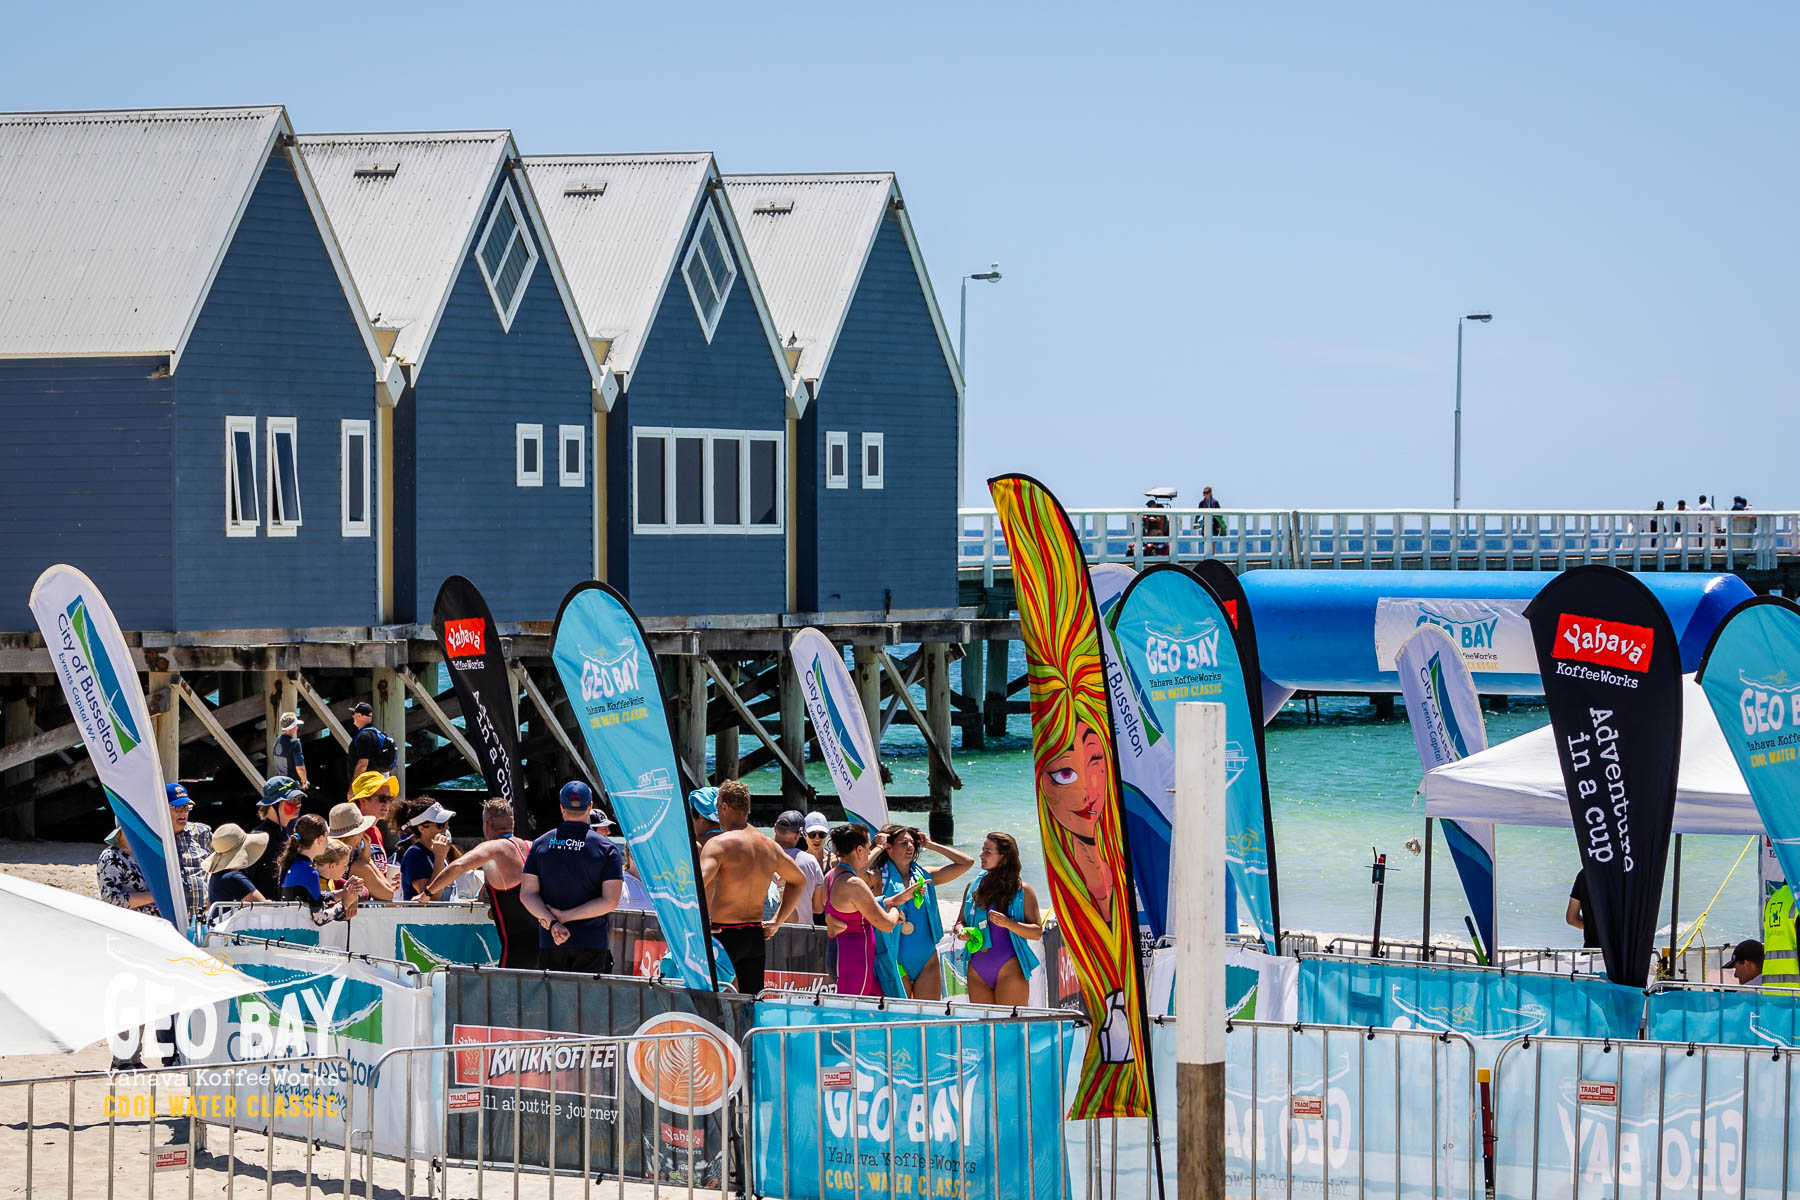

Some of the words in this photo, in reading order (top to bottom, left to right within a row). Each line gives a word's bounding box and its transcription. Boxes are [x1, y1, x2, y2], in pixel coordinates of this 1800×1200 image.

[448, 624, 481, 651] Yahava
[1145, 636, 1181, 675] GEO
[1186, 629, 1219, 670] BAY
[1461, 617, 1499, 649] BAY
[1563, 623, 1644, 665] Yahava
[58, 652, 74, 685] Events
[72, 687, 89, 723] Capital
[58, 613, 75, 650] City
[71, 655, 88, 674] of
[80, 675, 118, 764] Busselton
[581, 660, 614, 702] GEO
[612, 648, 639, 694] BAY
[1174, 672, 1222, 685] KoffeeWorks
[1191, 683, 1222, 696] CLASSIC
[1420, 667, 1432, 699] City
[1556, 661, 1639, 689] KoffeeWorks
[805, 670, 819, 701] City
[817, 704, 826, 719] of
[823, 719, 853, 791] Busselton
[1108, 671, 1144, 758] Busselton
[1421, 701, 1433, 729] Events
[1429, 731, 1443, 762] Capital
[1740, 688, 1784, 736] GEO
[1567, 732, 1591, 772] in
[1768, 747, 1796, 764] WATER
[1578, 779, 1597, 799] a
[1589, 707, 1634, 873] Adventure
[1585, 806, 1614, 863] cup
[450, 1094, 467, 1102] TRADE
[484, 1095, 498, 1110] ll
[502, 1096, 539, 1113] about
[566, 1102, 619, 1125] journey
[824, 1062, 898, 1142] GEO
[907, 1074, 979, 1147] BAY
[1581, 1086, 1600, 1094] TRADE
